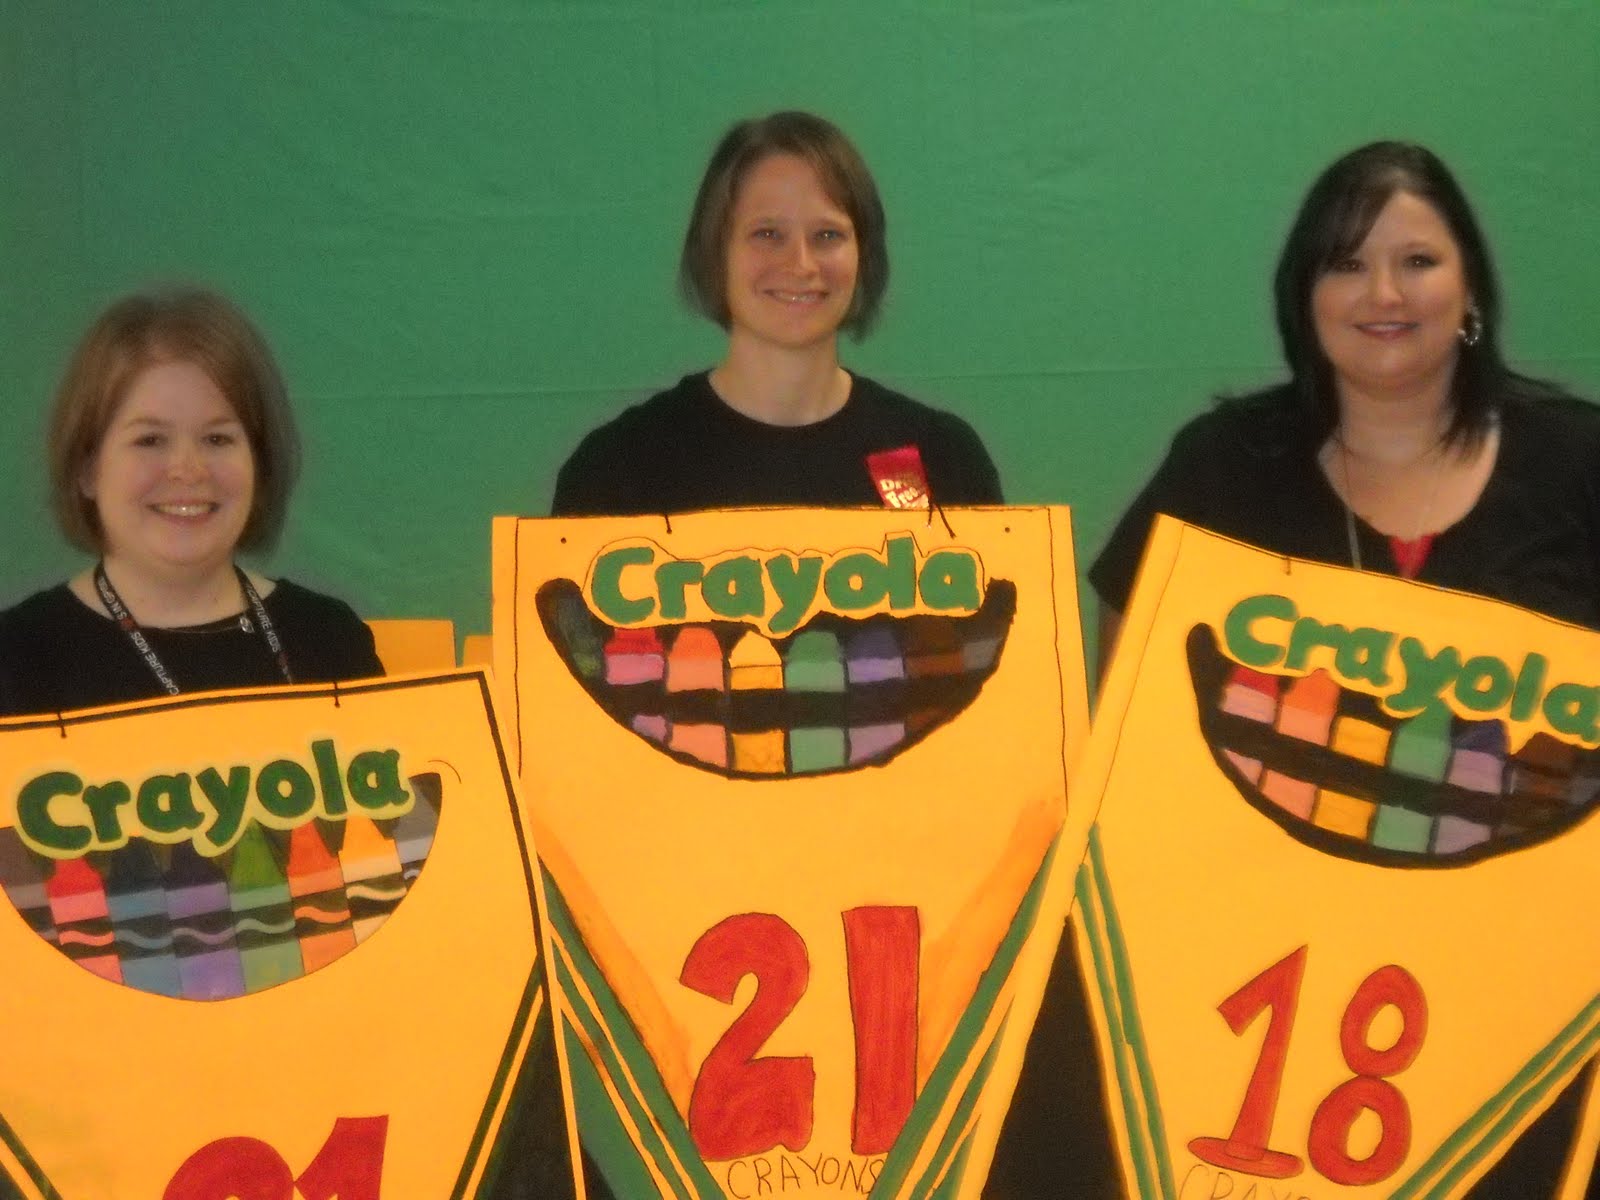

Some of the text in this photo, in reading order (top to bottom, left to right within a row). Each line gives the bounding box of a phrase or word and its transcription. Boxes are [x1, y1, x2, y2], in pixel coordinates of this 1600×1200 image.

[591, 536, 981, 634] Crayola
[144, 652, 180, 696] CAPTURE
[1224, 594, 1600, 742] Crayola
[17, 739, 409, 850] Crayola
[679, 905, 920, 1162] 21
[1187, 944, 1429, 1186] 18
[727, 1152, 885, 1200] CRAYONS
